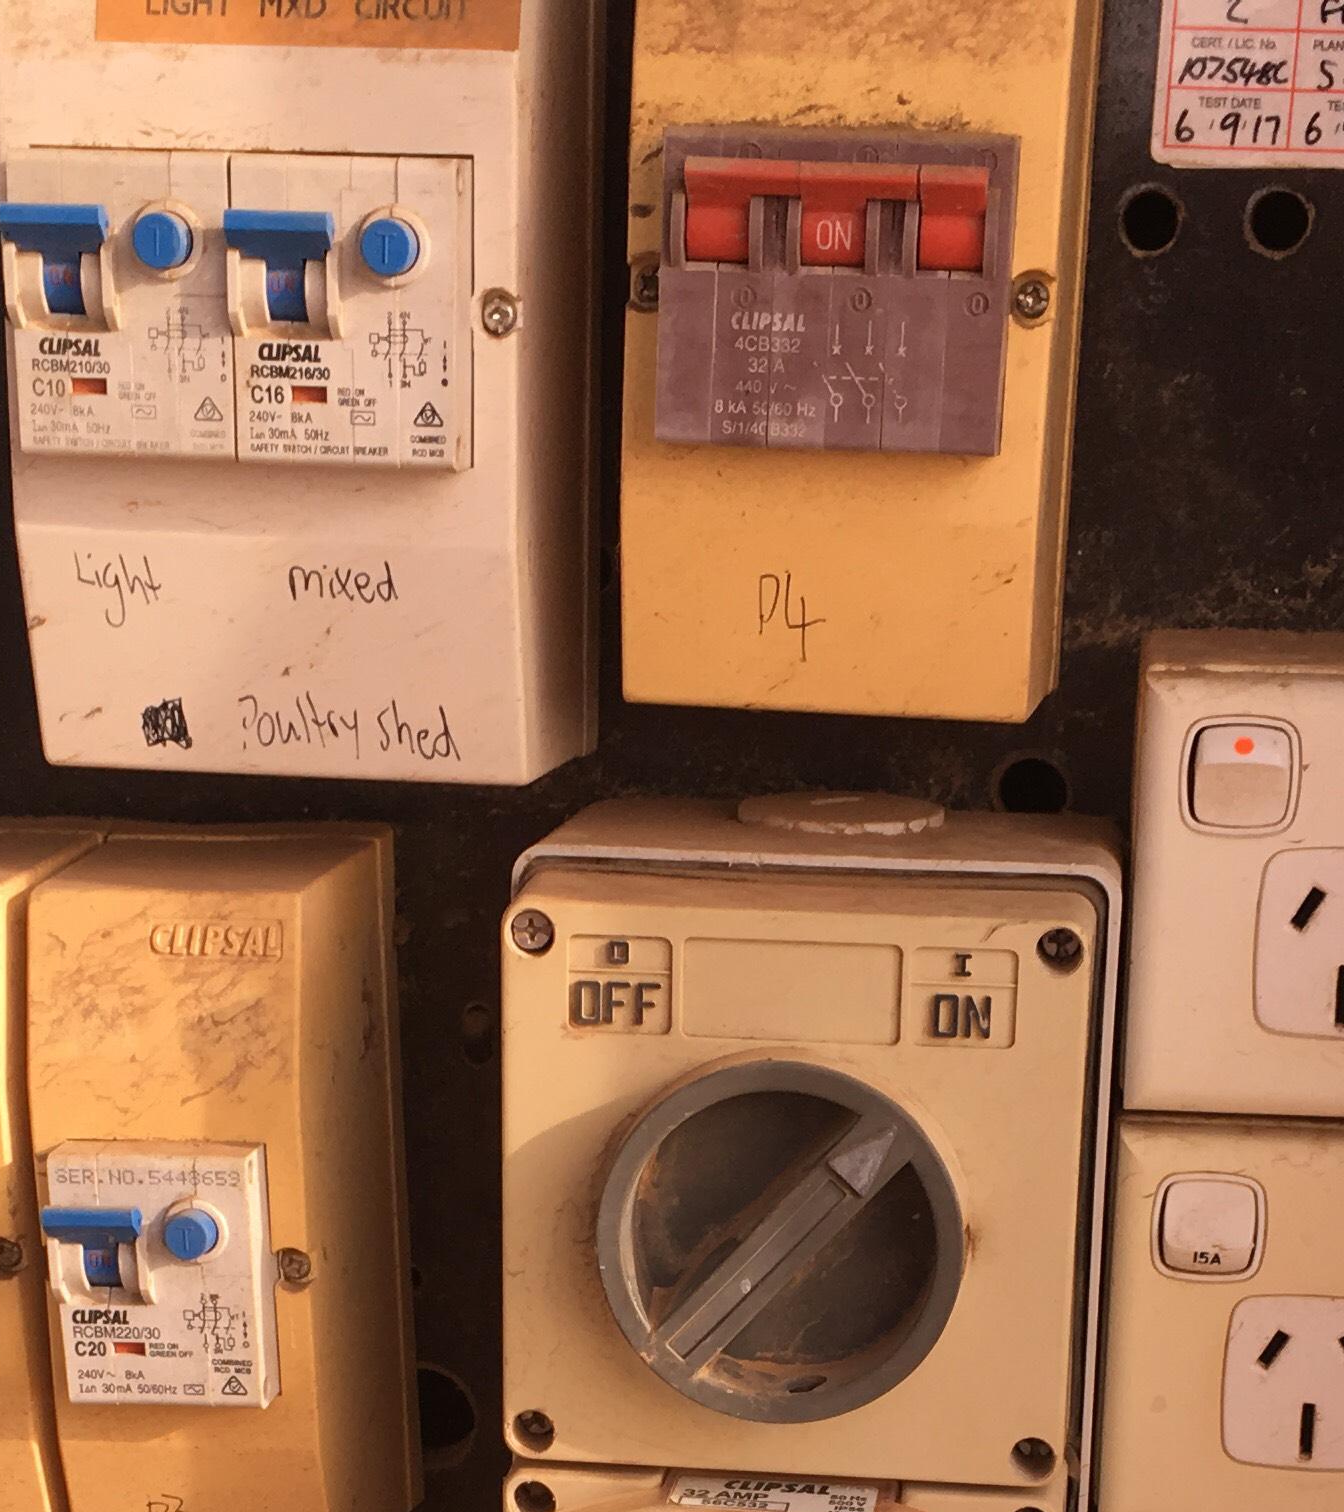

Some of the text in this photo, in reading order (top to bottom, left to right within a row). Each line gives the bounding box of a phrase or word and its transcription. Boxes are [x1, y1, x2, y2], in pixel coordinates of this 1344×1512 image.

[145, 0, 227, 17] LIGHT
[355, 0, 466, 21] CIRCUIT
[1198, 96, 1262, 110] TEST DATE
[816, 219, 853, 251] ON
[731, 311, 806, 332] CLIPSAL
[38, 336, 101, 357] CLIPSAL
[258, 342, 322, 363] CLIPSAL
[734, 335, 801, 353] 4CB332
[32, 358, 111, 375] RCBM210/30
[250, 364, 331, 380] RCBM216/30
[748, 357, 768, 373] 32
[32, 379, 66, 398] C10
[251, 385, 285, 404] C16
[736, 380, 762, 394] 440
[714, 399, 816, 417] 8 kA 50/60 Hz
[291, 412, 313, 424] 8kA
[268, 427, 330, 442] 30mA 50Hz
[73, 552, 399, 628] Light mixed
[757, 569, 827, 663] P4
[150, 919, 283, 959] CLIPSAL
[573, 978, 662, 1027] OFF
[930, 992, 992, 1041] ON
[1192, 1250, 1223, 1267] 15A
[71, 1309, 130, 1325] CLIPSAL
[72, 1326, 161, 1340] RCBM220/30
[74, 1341, 107, 1357] C20
[102, 1383, 133, 1394] 30mA
[683, 1488, 770, 1500] 32 AMP
[724, 1479, 831, 1495] CLIPSAL
